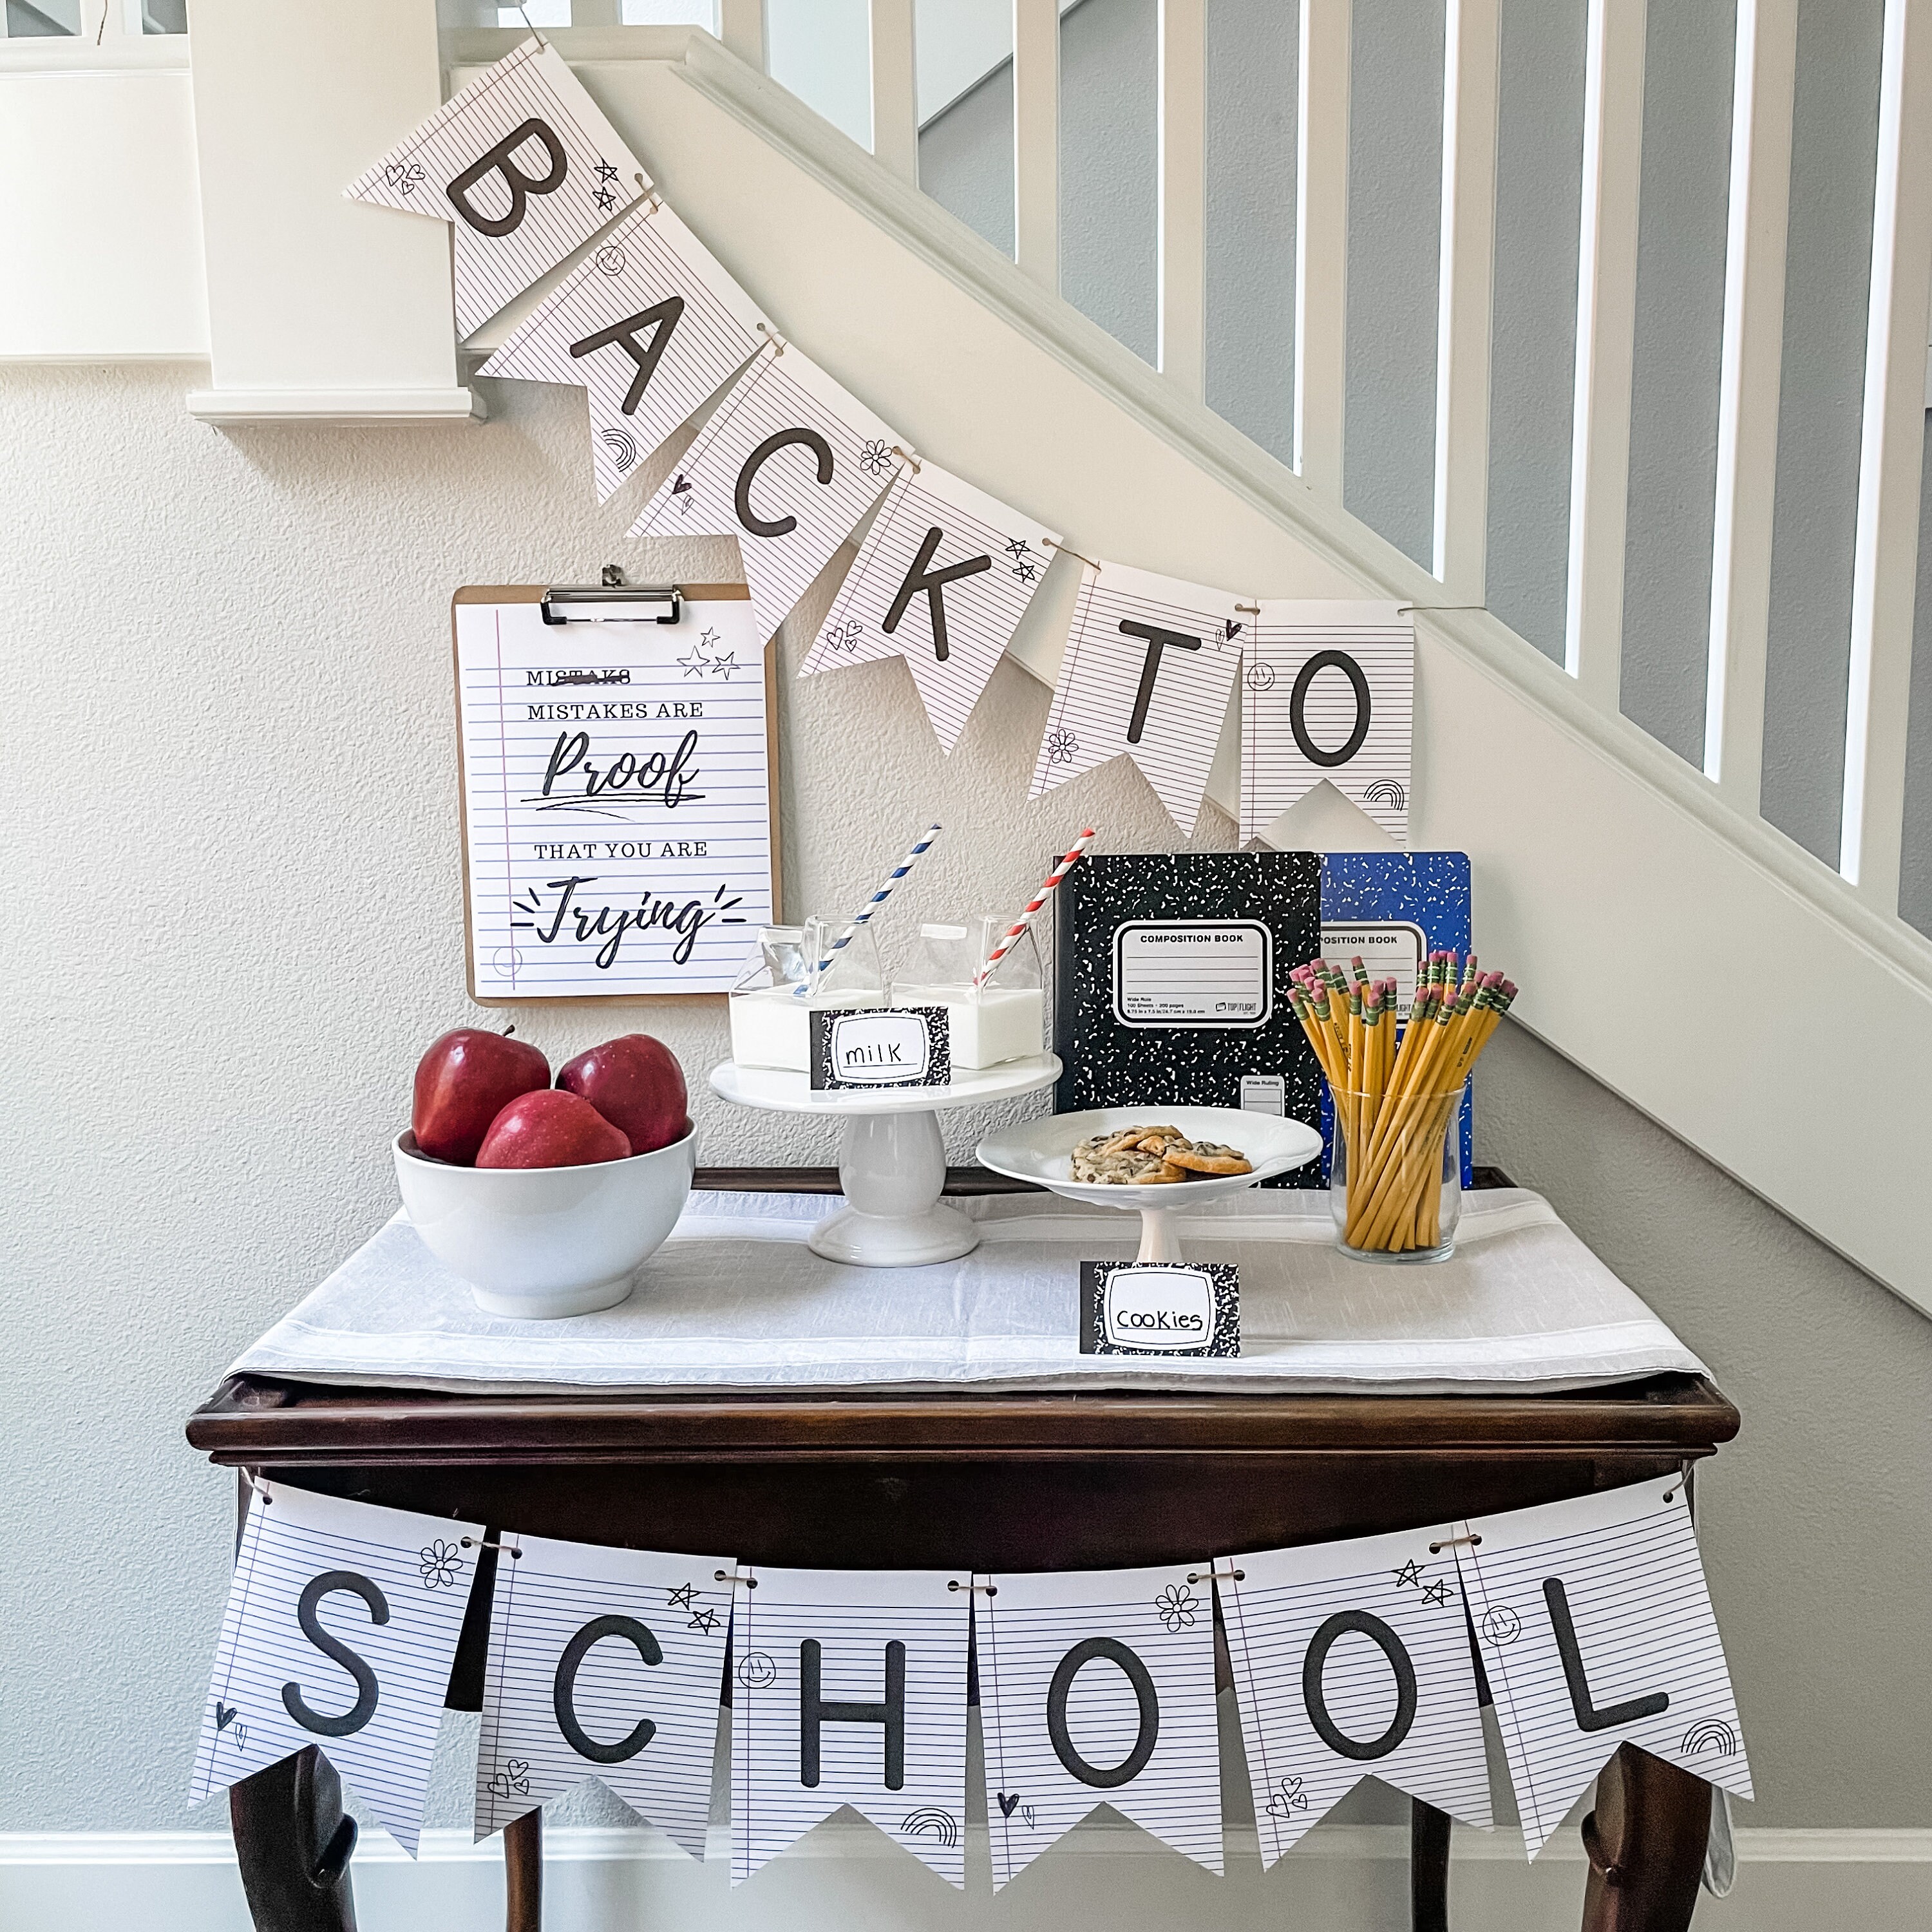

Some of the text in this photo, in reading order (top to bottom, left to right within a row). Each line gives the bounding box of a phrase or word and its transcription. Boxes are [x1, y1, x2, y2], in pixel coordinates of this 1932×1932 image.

[446, 117, 1371, 767] BACK TO
[527, 703, 703, 720] MISTAKES ARE
[542, 730, 699, 809] Proof
[534, 842, 707, 859] THAT YOU ARE
[536, 876, 717, 969] Trying
[1140, 934, 1211, 943] COMPOSITION
[846, 1043, 902, 1065] milk
[281, 1569, 1669, 1791] SCHOOL
